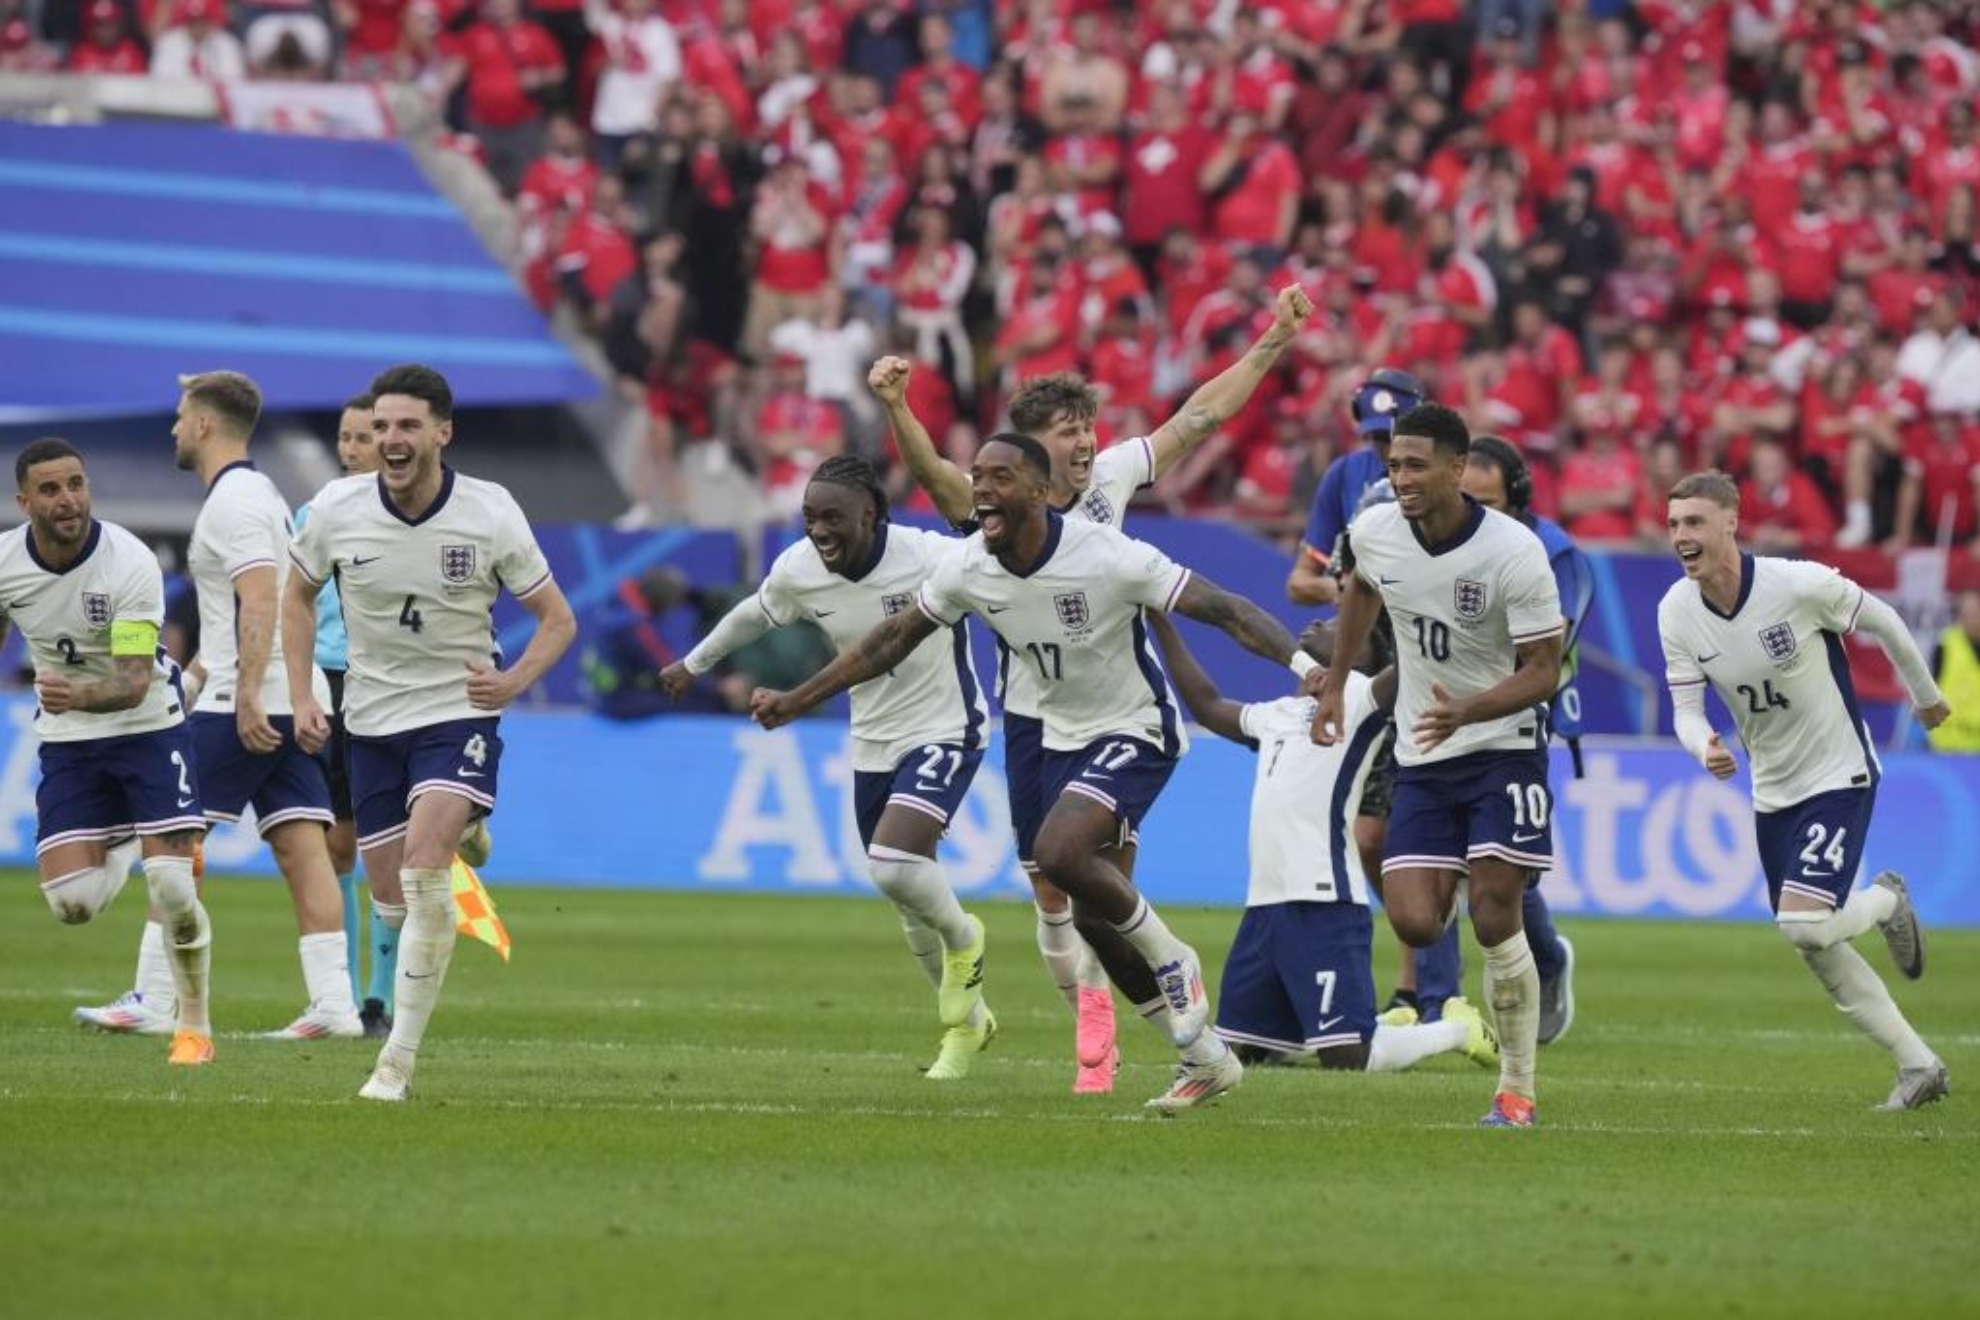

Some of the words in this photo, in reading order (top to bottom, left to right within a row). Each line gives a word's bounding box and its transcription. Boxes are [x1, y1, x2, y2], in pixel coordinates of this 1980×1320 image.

[399, 594, 423, 634] 4
[56, 637, 85, 666] 2
[1413, 616, 1450, 662] 10
[1026, 641, 1063, 682] 17
[1737, 679, 1790, 713] 24
[463, 733, 487, 768] 4
[916, 744, 963, 787] 21
[1092, 740, 1138, 771] 17
[170, 750, 191, 794] 2
[1506, 782, 1548, 830] 10
[1799, 822, 1847, 872] 24
[1315, 970, 1338, 1015] 7
